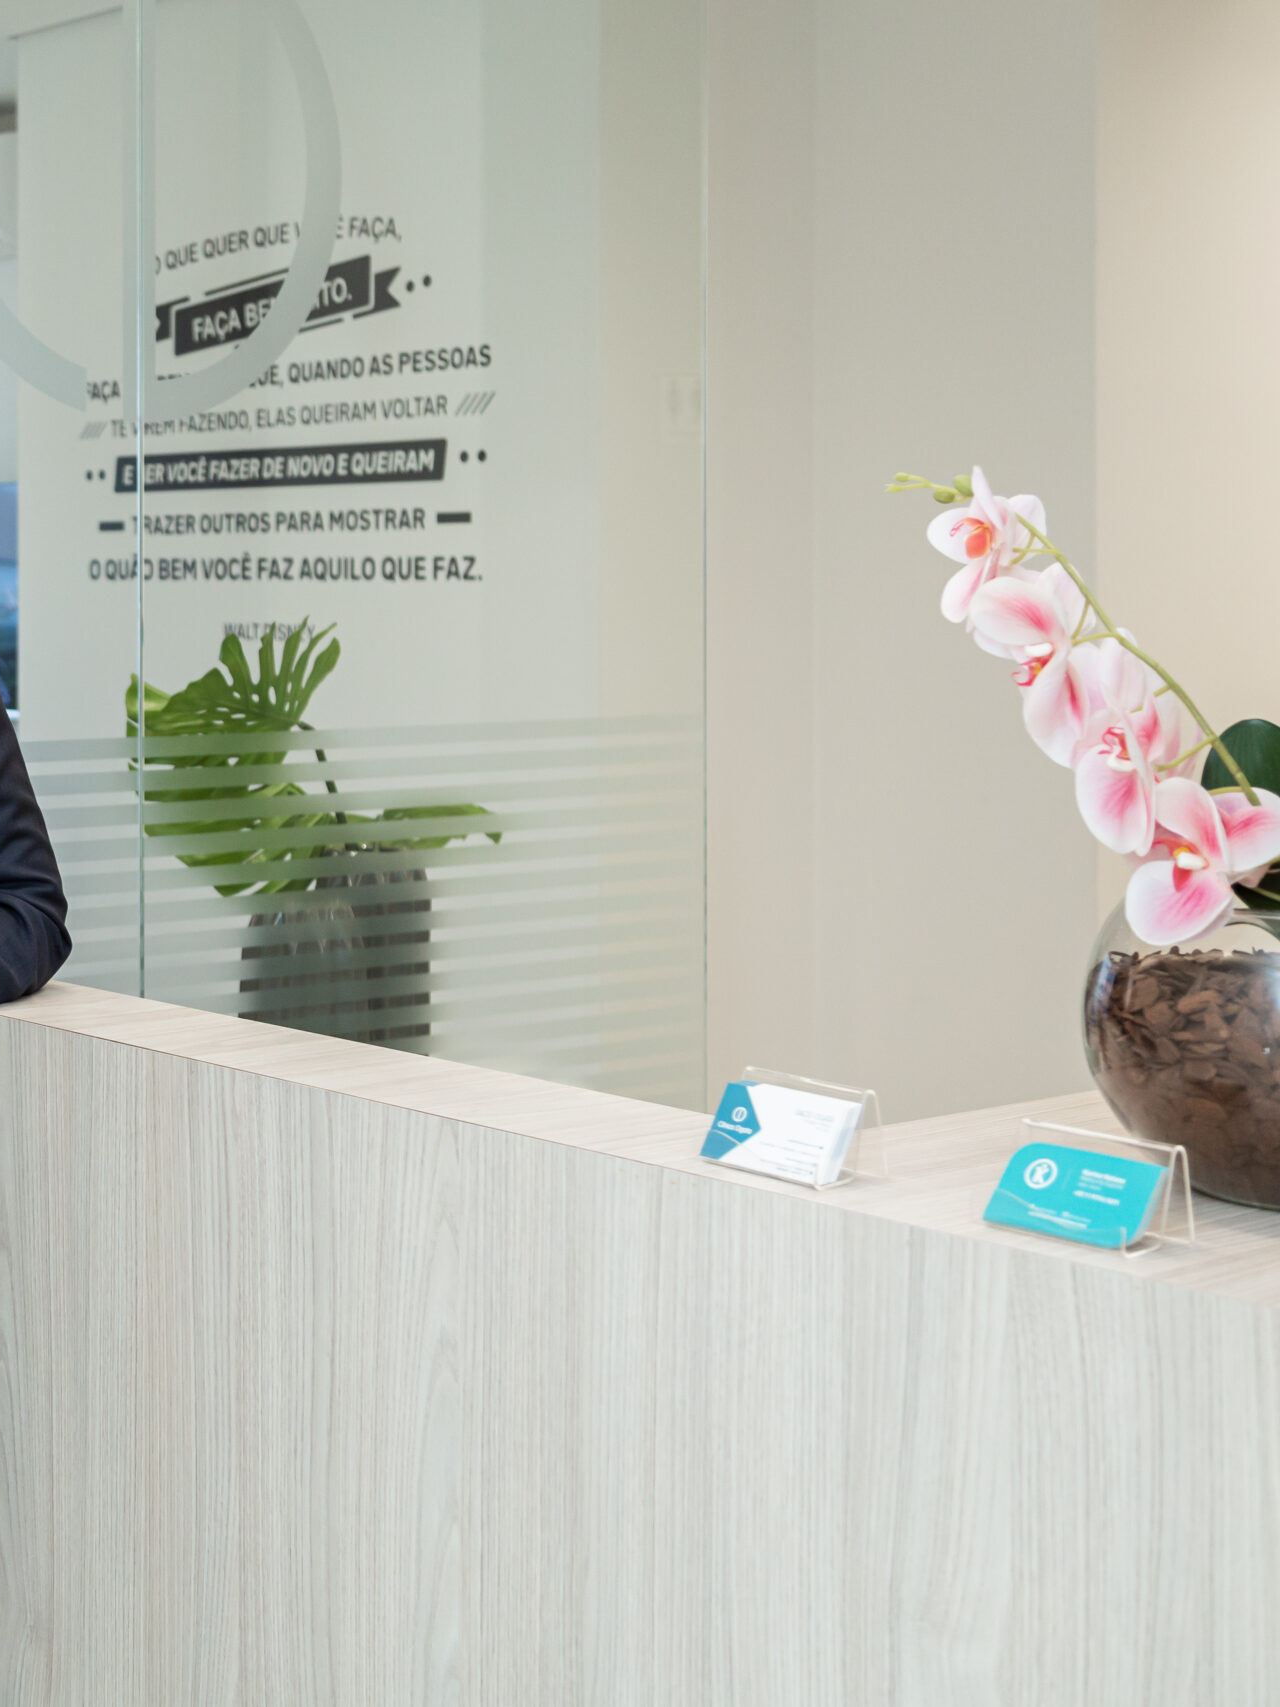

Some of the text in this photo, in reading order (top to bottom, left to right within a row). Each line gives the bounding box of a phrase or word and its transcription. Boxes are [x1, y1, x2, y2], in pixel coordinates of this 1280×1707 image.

[165, 242, 198, 270] QUE
[203, 229, 249, 259] QUER
[254, 222, 290, 247] QUE
[349, 216, 402, 243] FAÇA,
[191, 307, 241, 342] FAÇA
[288, 356, 365, 384] QUANDO
[369, 353, 394, 377] AS
[399, 344, 492, 374] PESSOAS
[111, 419, 126, 438] TE
[256, 406, 297, 429] ELAS
[301, 401, 377, 426] QUEIRAM
[381, 394, 448, 420] VOLTAR
[123, 448, 436, 486] E ER VOCÊ FAZER DE NOVO E QUEIRAM
[200, 512, 271, 535] OUTROS
[275, 511, 325, 533] PARA
[329, 507, 426, 531] MOSTRAR
[89, 559, 102, 580] O
[158, 558, 198, 580] BEM
[201, 551, 253, 580] VOCÊ
[257, 557, 295, 580] FAZ
[299, 556, 376, 581] AQUILO
[381, 556, 427, 581] QUE
[432, 556, 483, 581] FAZ.
